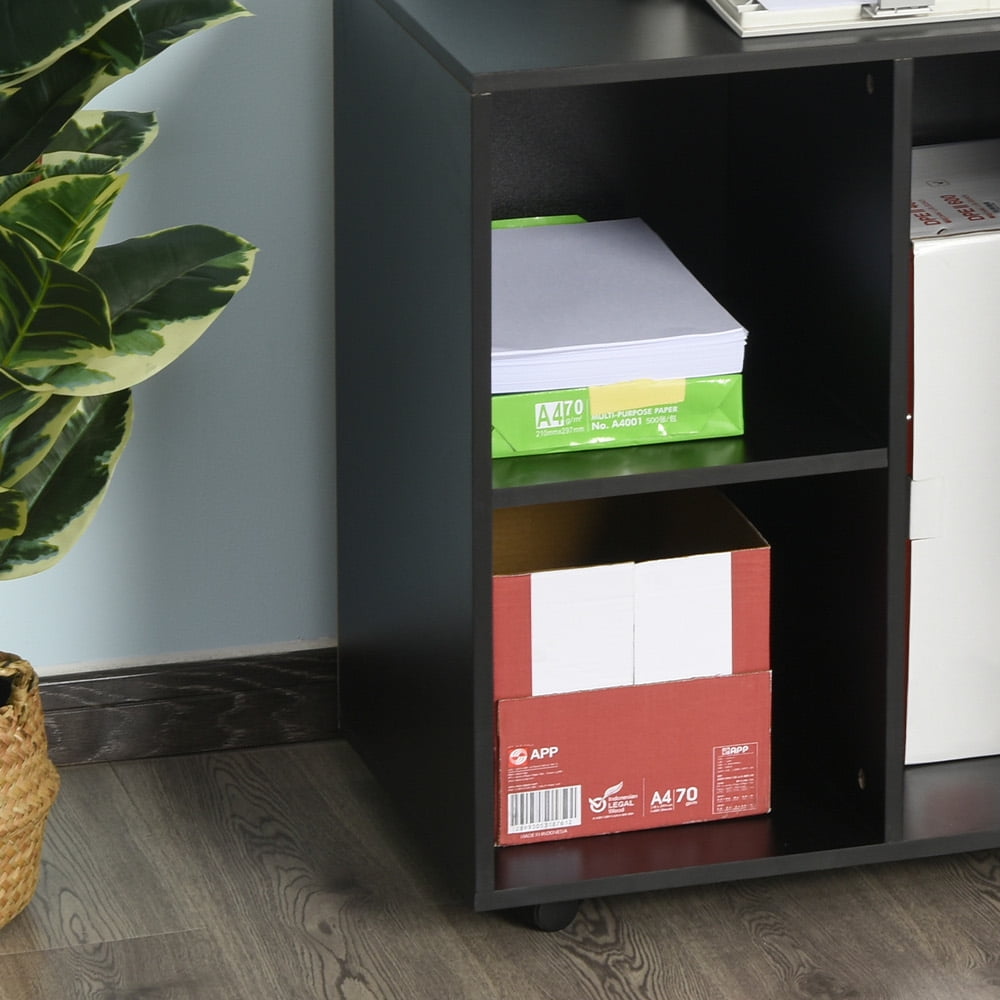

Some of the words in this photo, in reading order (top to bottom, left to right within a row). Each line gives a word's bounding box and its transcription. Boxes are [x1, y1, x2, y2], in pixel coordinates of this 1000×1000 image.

[536, 401, 564, 428] A4
[565, 399, 584, 415] 70
[592, 421, 609, 431] No.
[611, 417, 642, 428] A4001
[529, 746, 559, 760] APP
[650, 789, 672, 805] A4
[676, 786, 698, 802] 70
[607, 800, 635, 808] LEGAL
